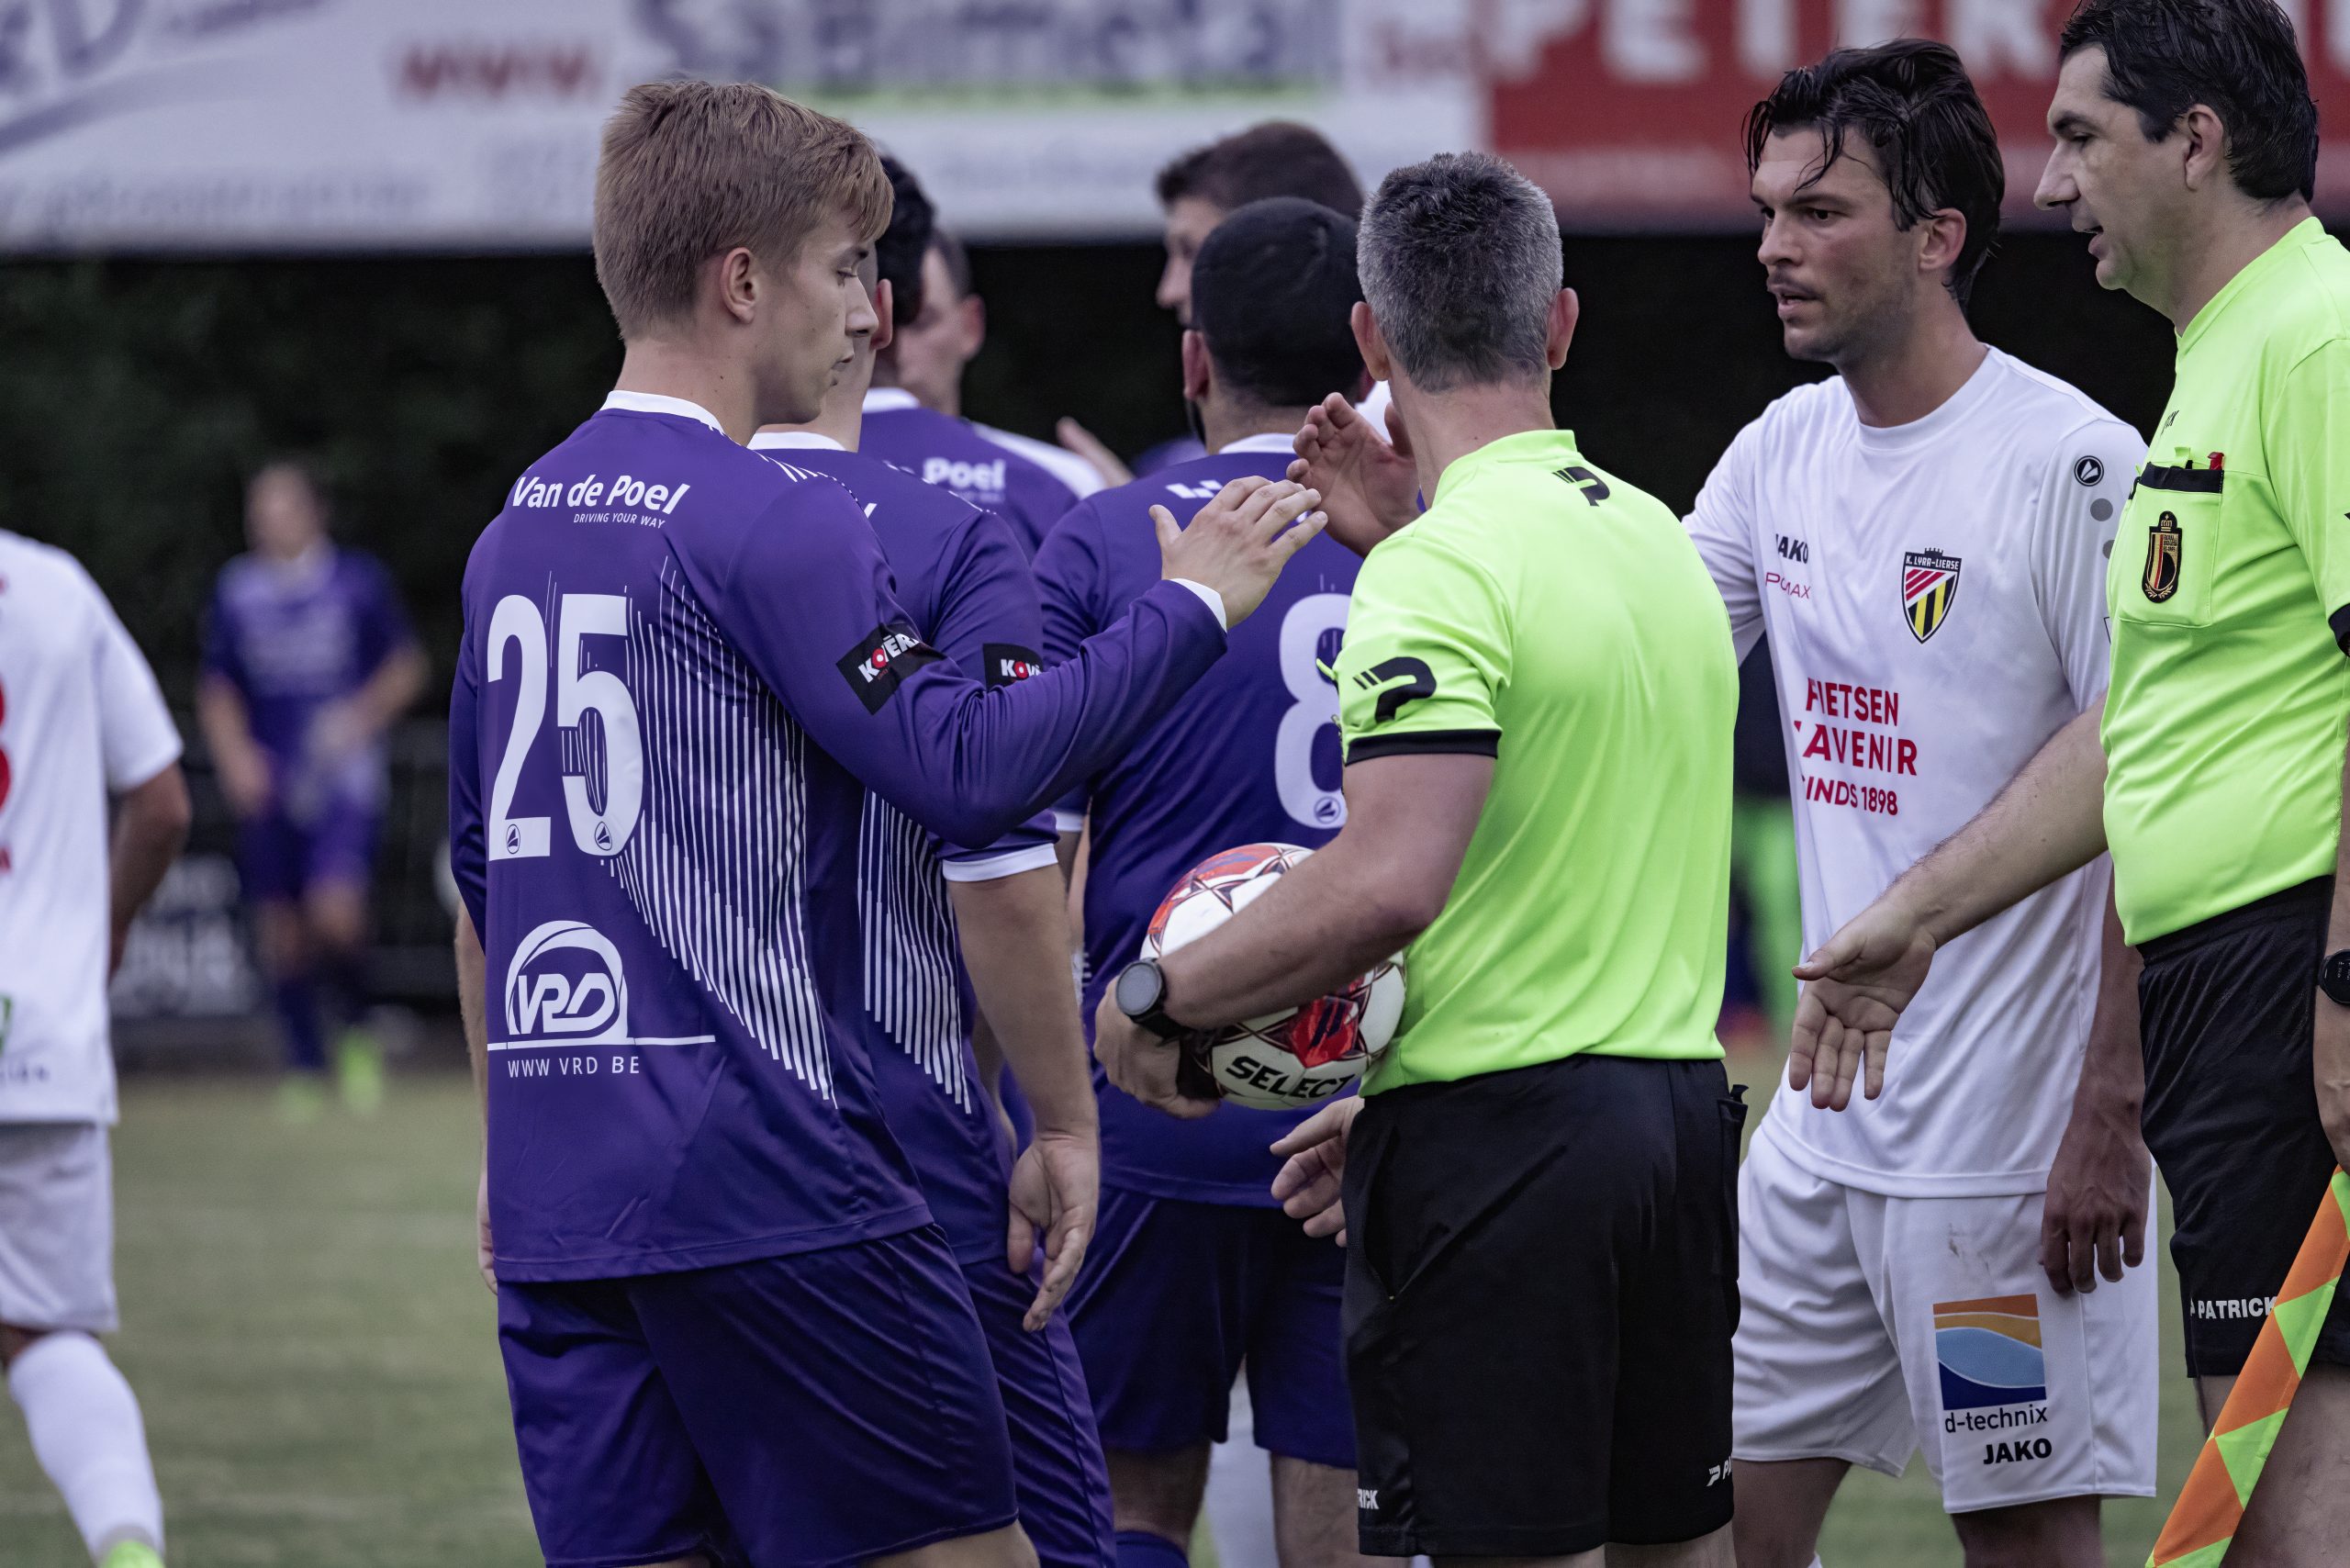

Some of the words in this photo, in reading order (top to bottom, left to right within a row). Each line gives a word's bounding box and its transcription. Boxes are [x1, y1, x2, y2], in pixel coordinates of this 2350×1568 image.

[512, 476, 564, 508] Van
[566, 474, 604, 508] de
[605, 475, 691, 515] Poel
[573, 512, 610, 523] DRIVING
[612, 512, 637, 524] YOUR
[640, 516, 666, 529] WAY
[1914, 555, 1960, 570] LYRA-LIERSE
[487, 593, 643, 861] 25
[1801, 774, 1858, 808] INDS
[1861, 786, 1898, 815] 1898
[507, 1058, 551, 1079] WWW
[558, 1057, 599, 1076] VRD
[611, 1056, 640, 1074] BE
[1944, 1404, 2048, 1433] d-technix
[1983, 1438, 2053, 1465] JAKO
